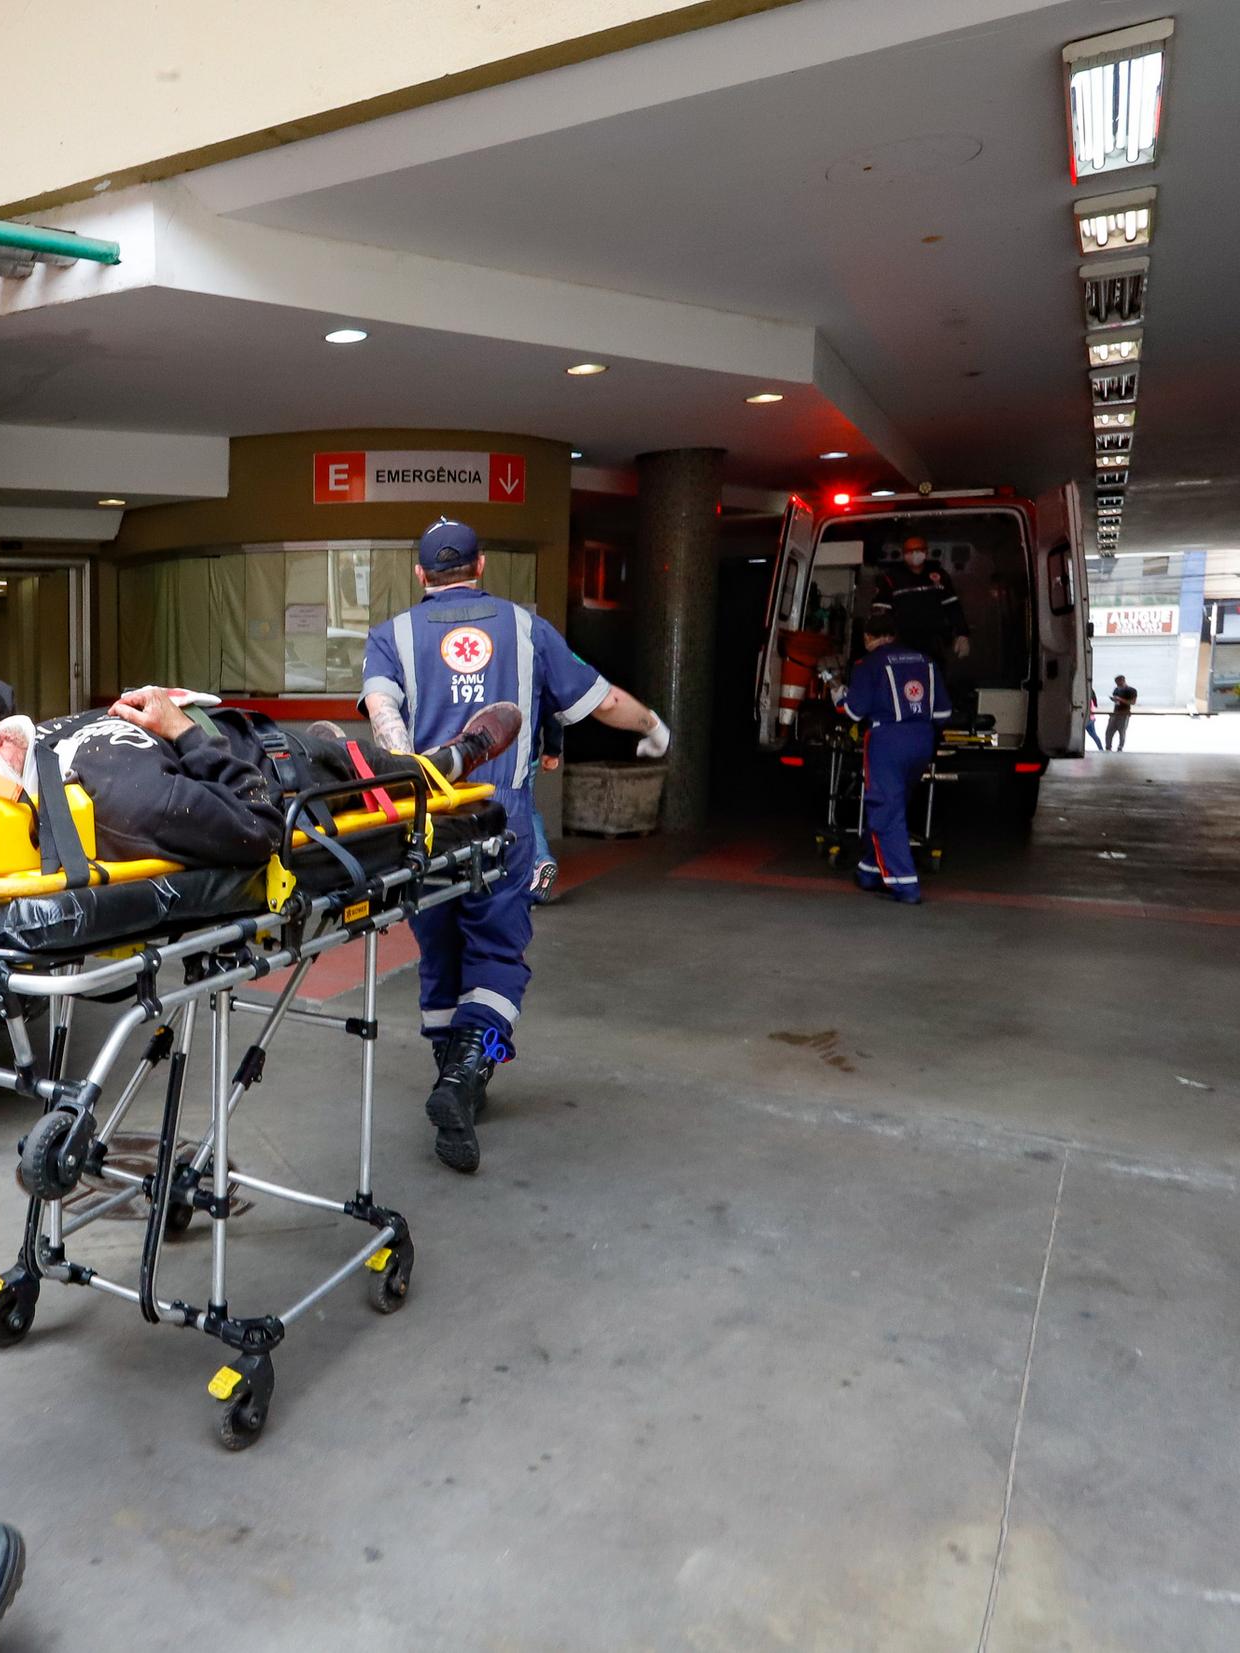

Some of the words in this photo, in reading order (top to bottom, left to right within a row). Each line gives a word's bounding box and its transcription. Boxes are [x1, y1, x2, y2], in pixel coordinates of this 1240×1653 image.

[328, 463, 350, 491] E
[375, 466, 482, 484] EMERGÊNCIA
[451, 673, 485, 685] SAMU
[450, 684, 485, 704] 192
